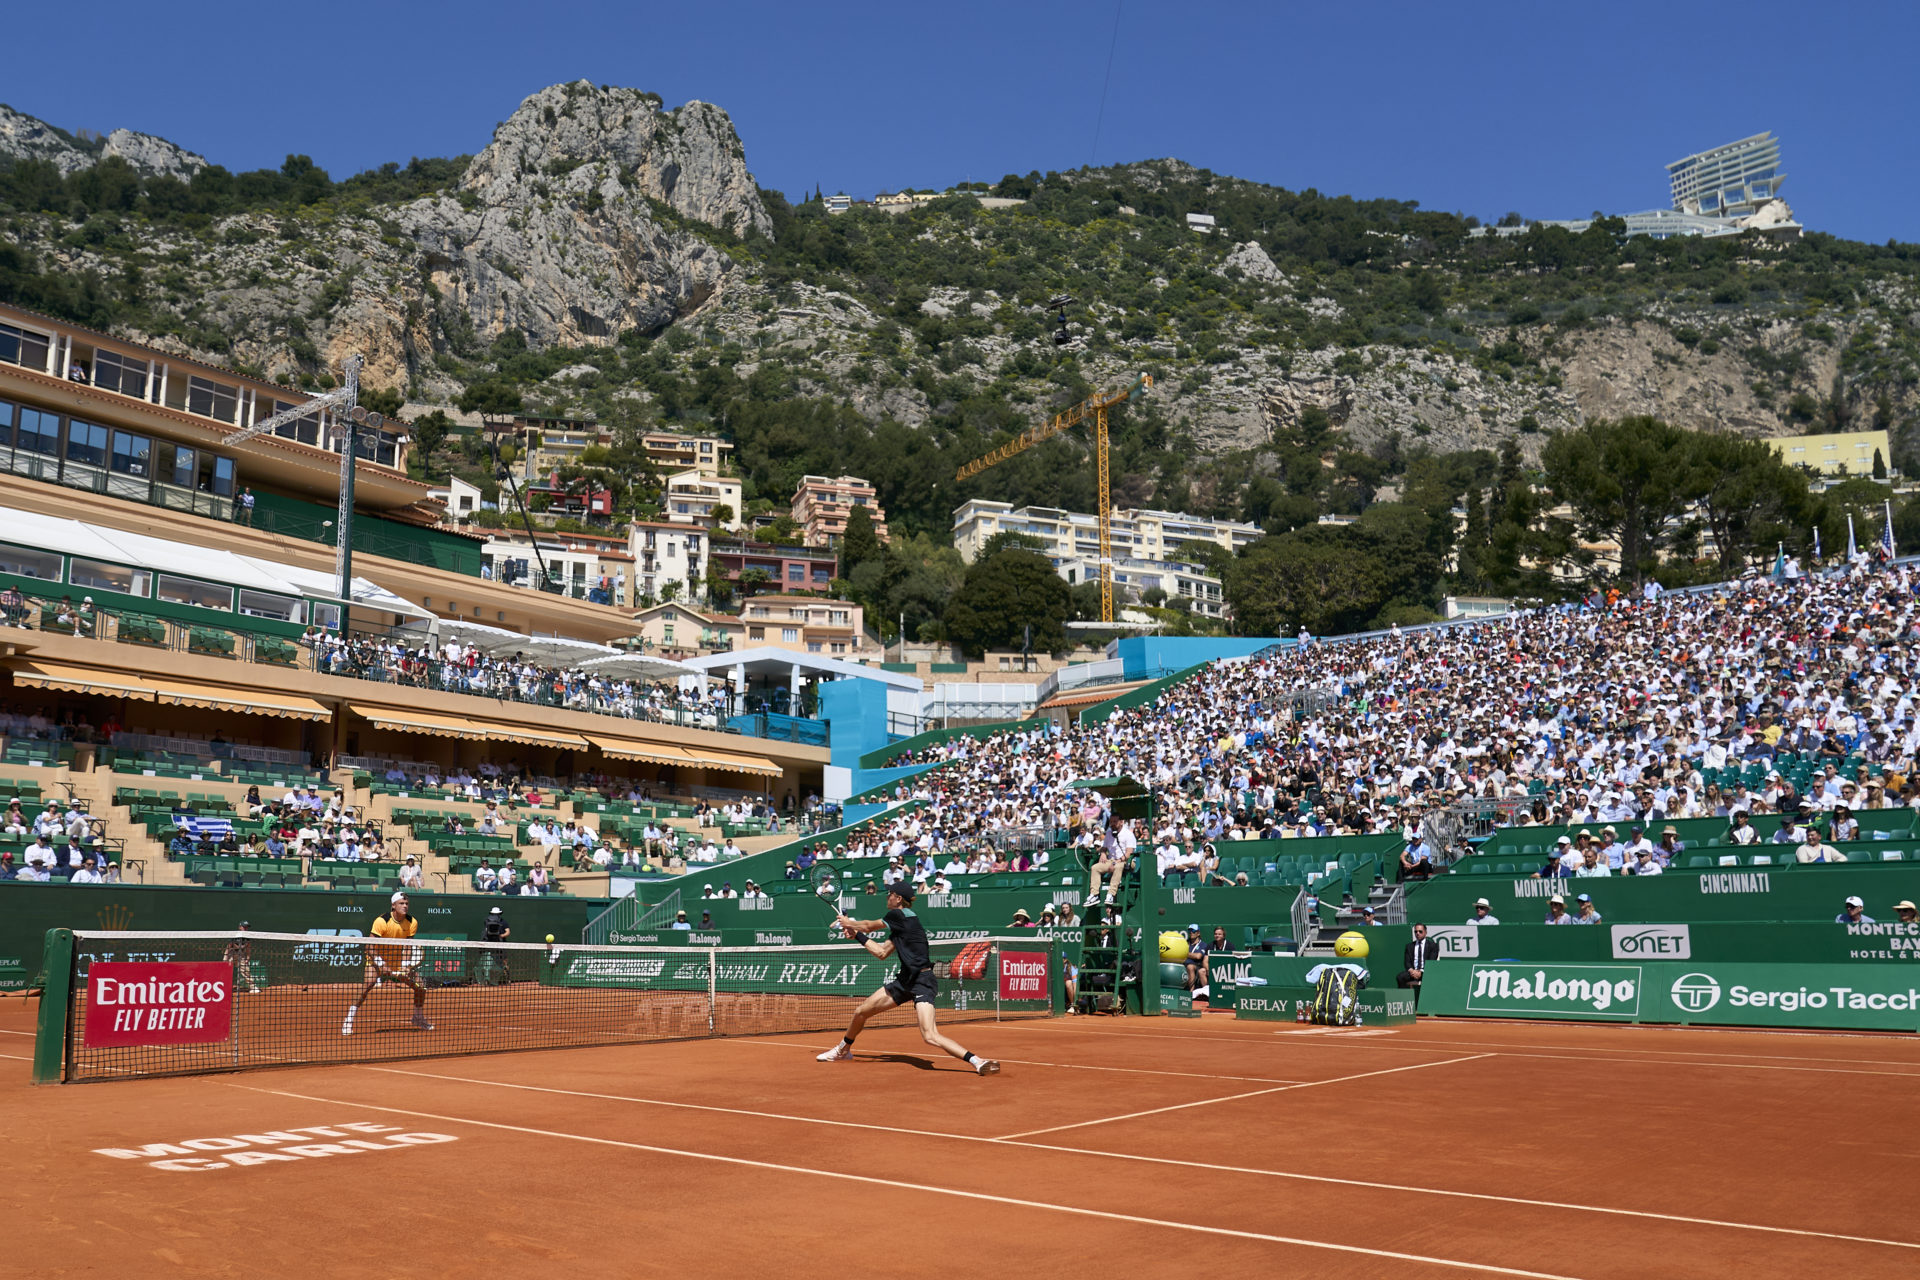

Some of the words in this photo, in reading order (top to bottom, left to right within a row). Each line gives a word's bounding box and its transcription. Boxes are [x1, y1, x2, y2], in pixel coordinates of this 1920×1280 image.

[1700, 873, 1770, 894] CINCINNATI
[928, 893, 971, 908] MONTE-CARLO
[1053, 891, 1080, 906] MADRID
[1173, 888, 1196, 904] ROME
[757, 898, 774, 911] WELLS
[619, 935, 636, 944] Sergio
[636, 934, 659, 943] Tacchini
[688, 933, 721, 947] Malongo
[756, 932, 792, 947] Malongo
[934, 930, 990, 940] DUNLOP
[1035, 928, 1083, 943] Adecco
[1426, 934, 1474, 953] NET
[1850, 950, 1894, 959] HOTEL
[1899, 951, 1907, 959] &
[777, 963, 868, 985] REPLAY
[1002, 959, 1046, 977] Emirates
[96, 976, 225, 1006] Emirates
[1009, 978, 1020, 991] FLY
[1020, 977, 1040, 991] BETTER
[1472, 969, 1635, 1011] Malongo
[1240, 998, 1288, 1012] REPLAY
[1728, 985, 1828, 1012] Sergio
[1355, 1003, 1385, 1014] EPLAY
[1387, 1001, 1415, 1017] REPLAY
[113, 1009, 144, 1032] FLY
[147, 1007, 206, 1031] BETTER
[89, 1121, 404, 1160] MONTE
[146, 1132, 460, 1172] CARLO
